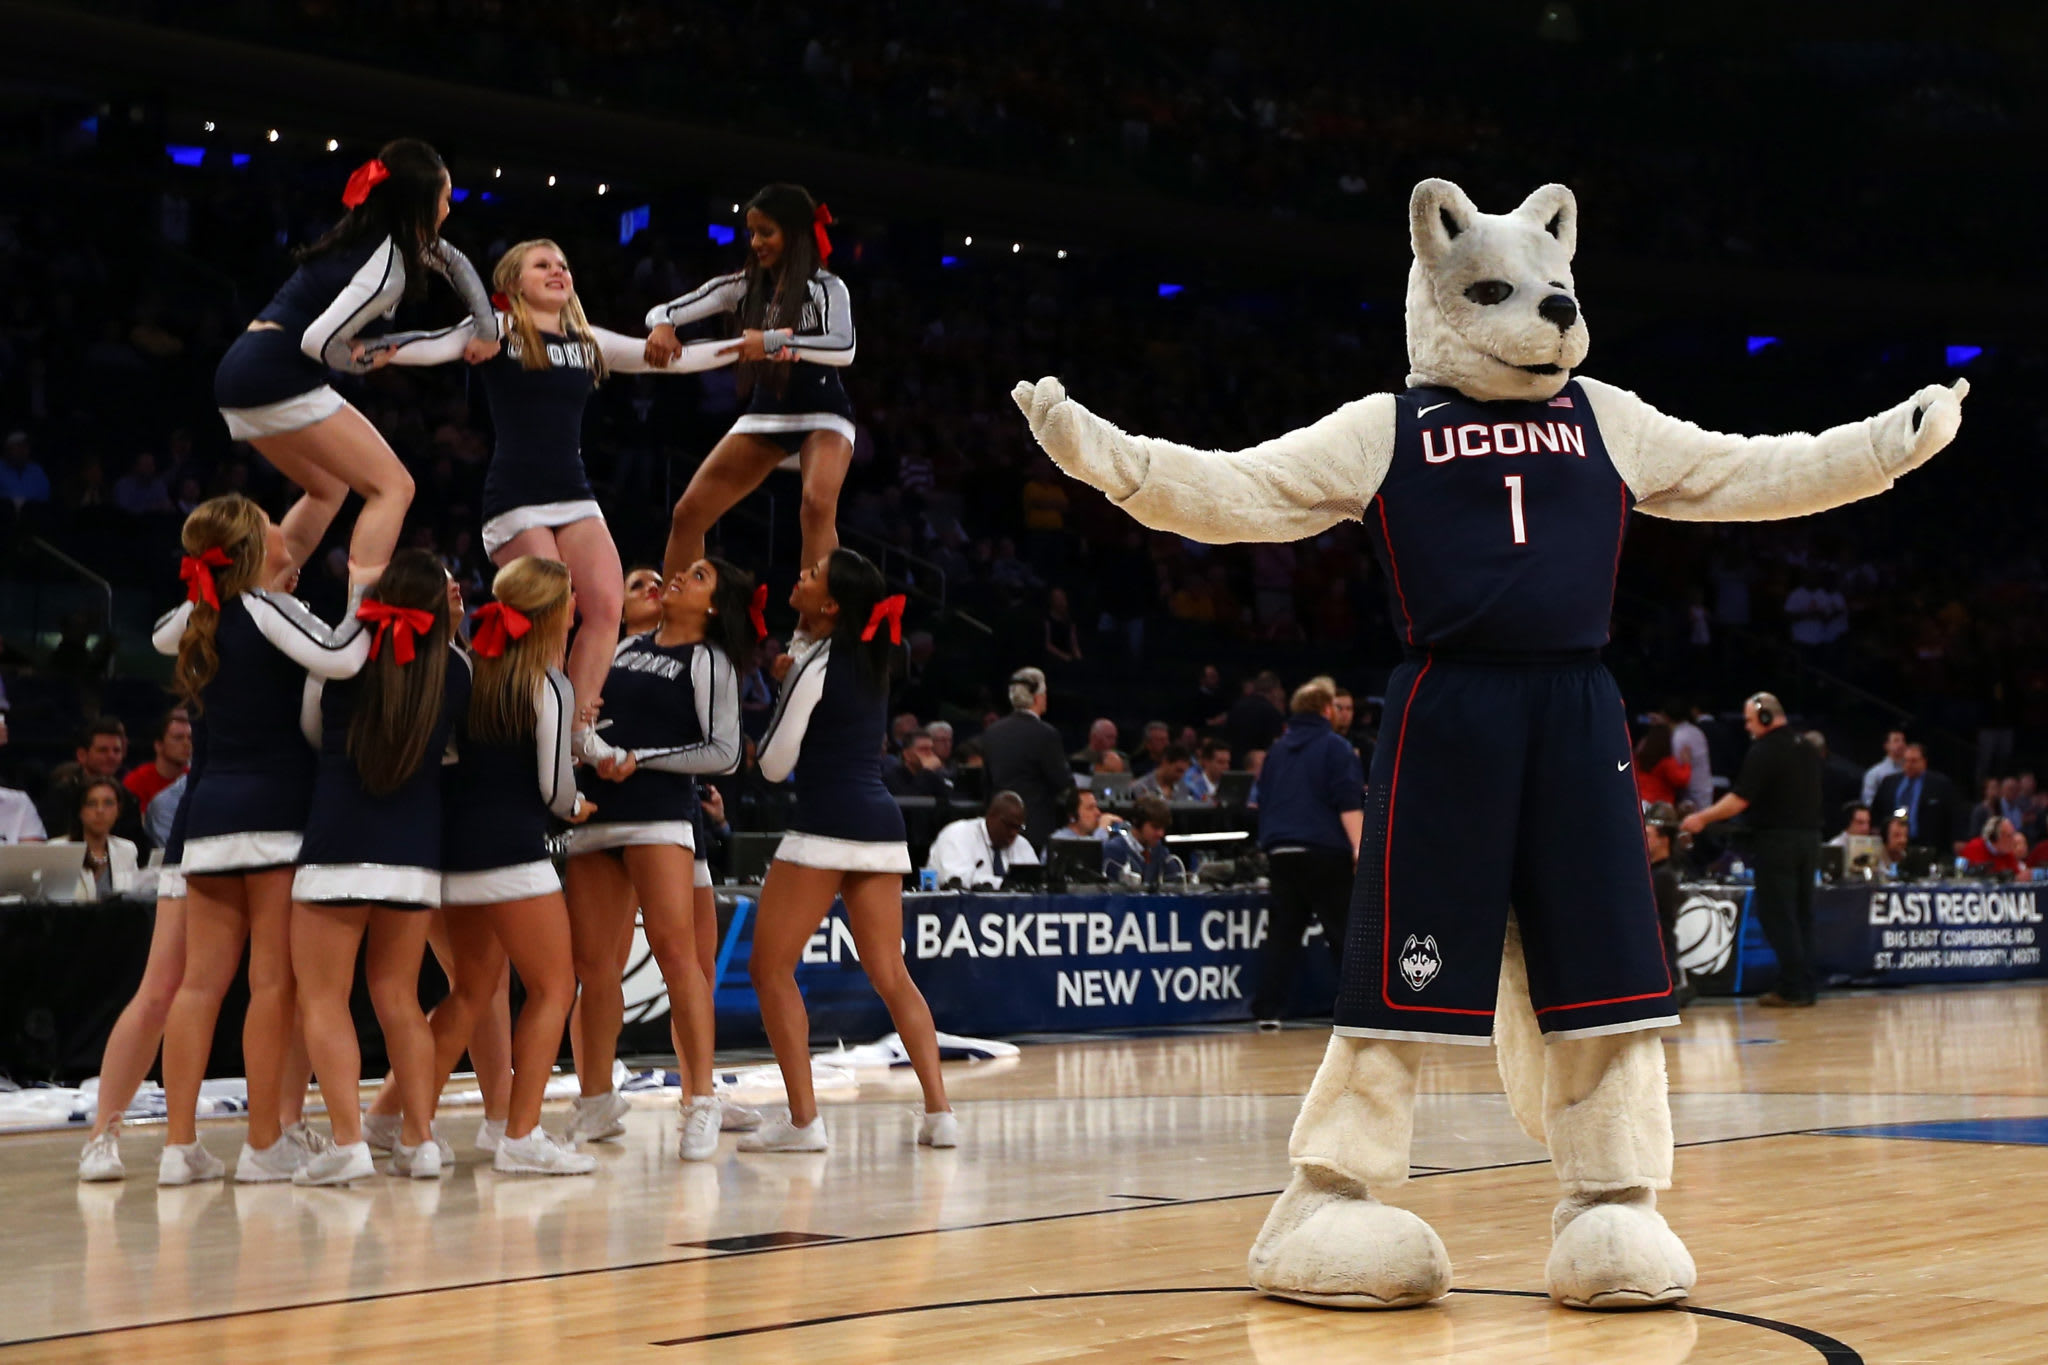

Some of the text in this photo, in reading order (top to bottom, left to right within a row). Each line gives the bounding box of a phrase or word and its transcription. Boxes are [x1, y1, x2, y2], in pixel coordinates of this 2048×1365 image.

[507, 341, 596, 369] UONN
[1421, 422, 1587, 464] UCONN
[1503, 474, 1527, 544] 1
[1869, 892, 2043, 925] EAST REGIONAL
[917, 911, 1192, 958] BASKETBALL
[1200, 909, 1269, 951] CHA
[1882, 930, 1907, 948] BIG
[1908, 930, 1940, 947] EAST
[1057, 965, 1243, 1007] NEW YORK
